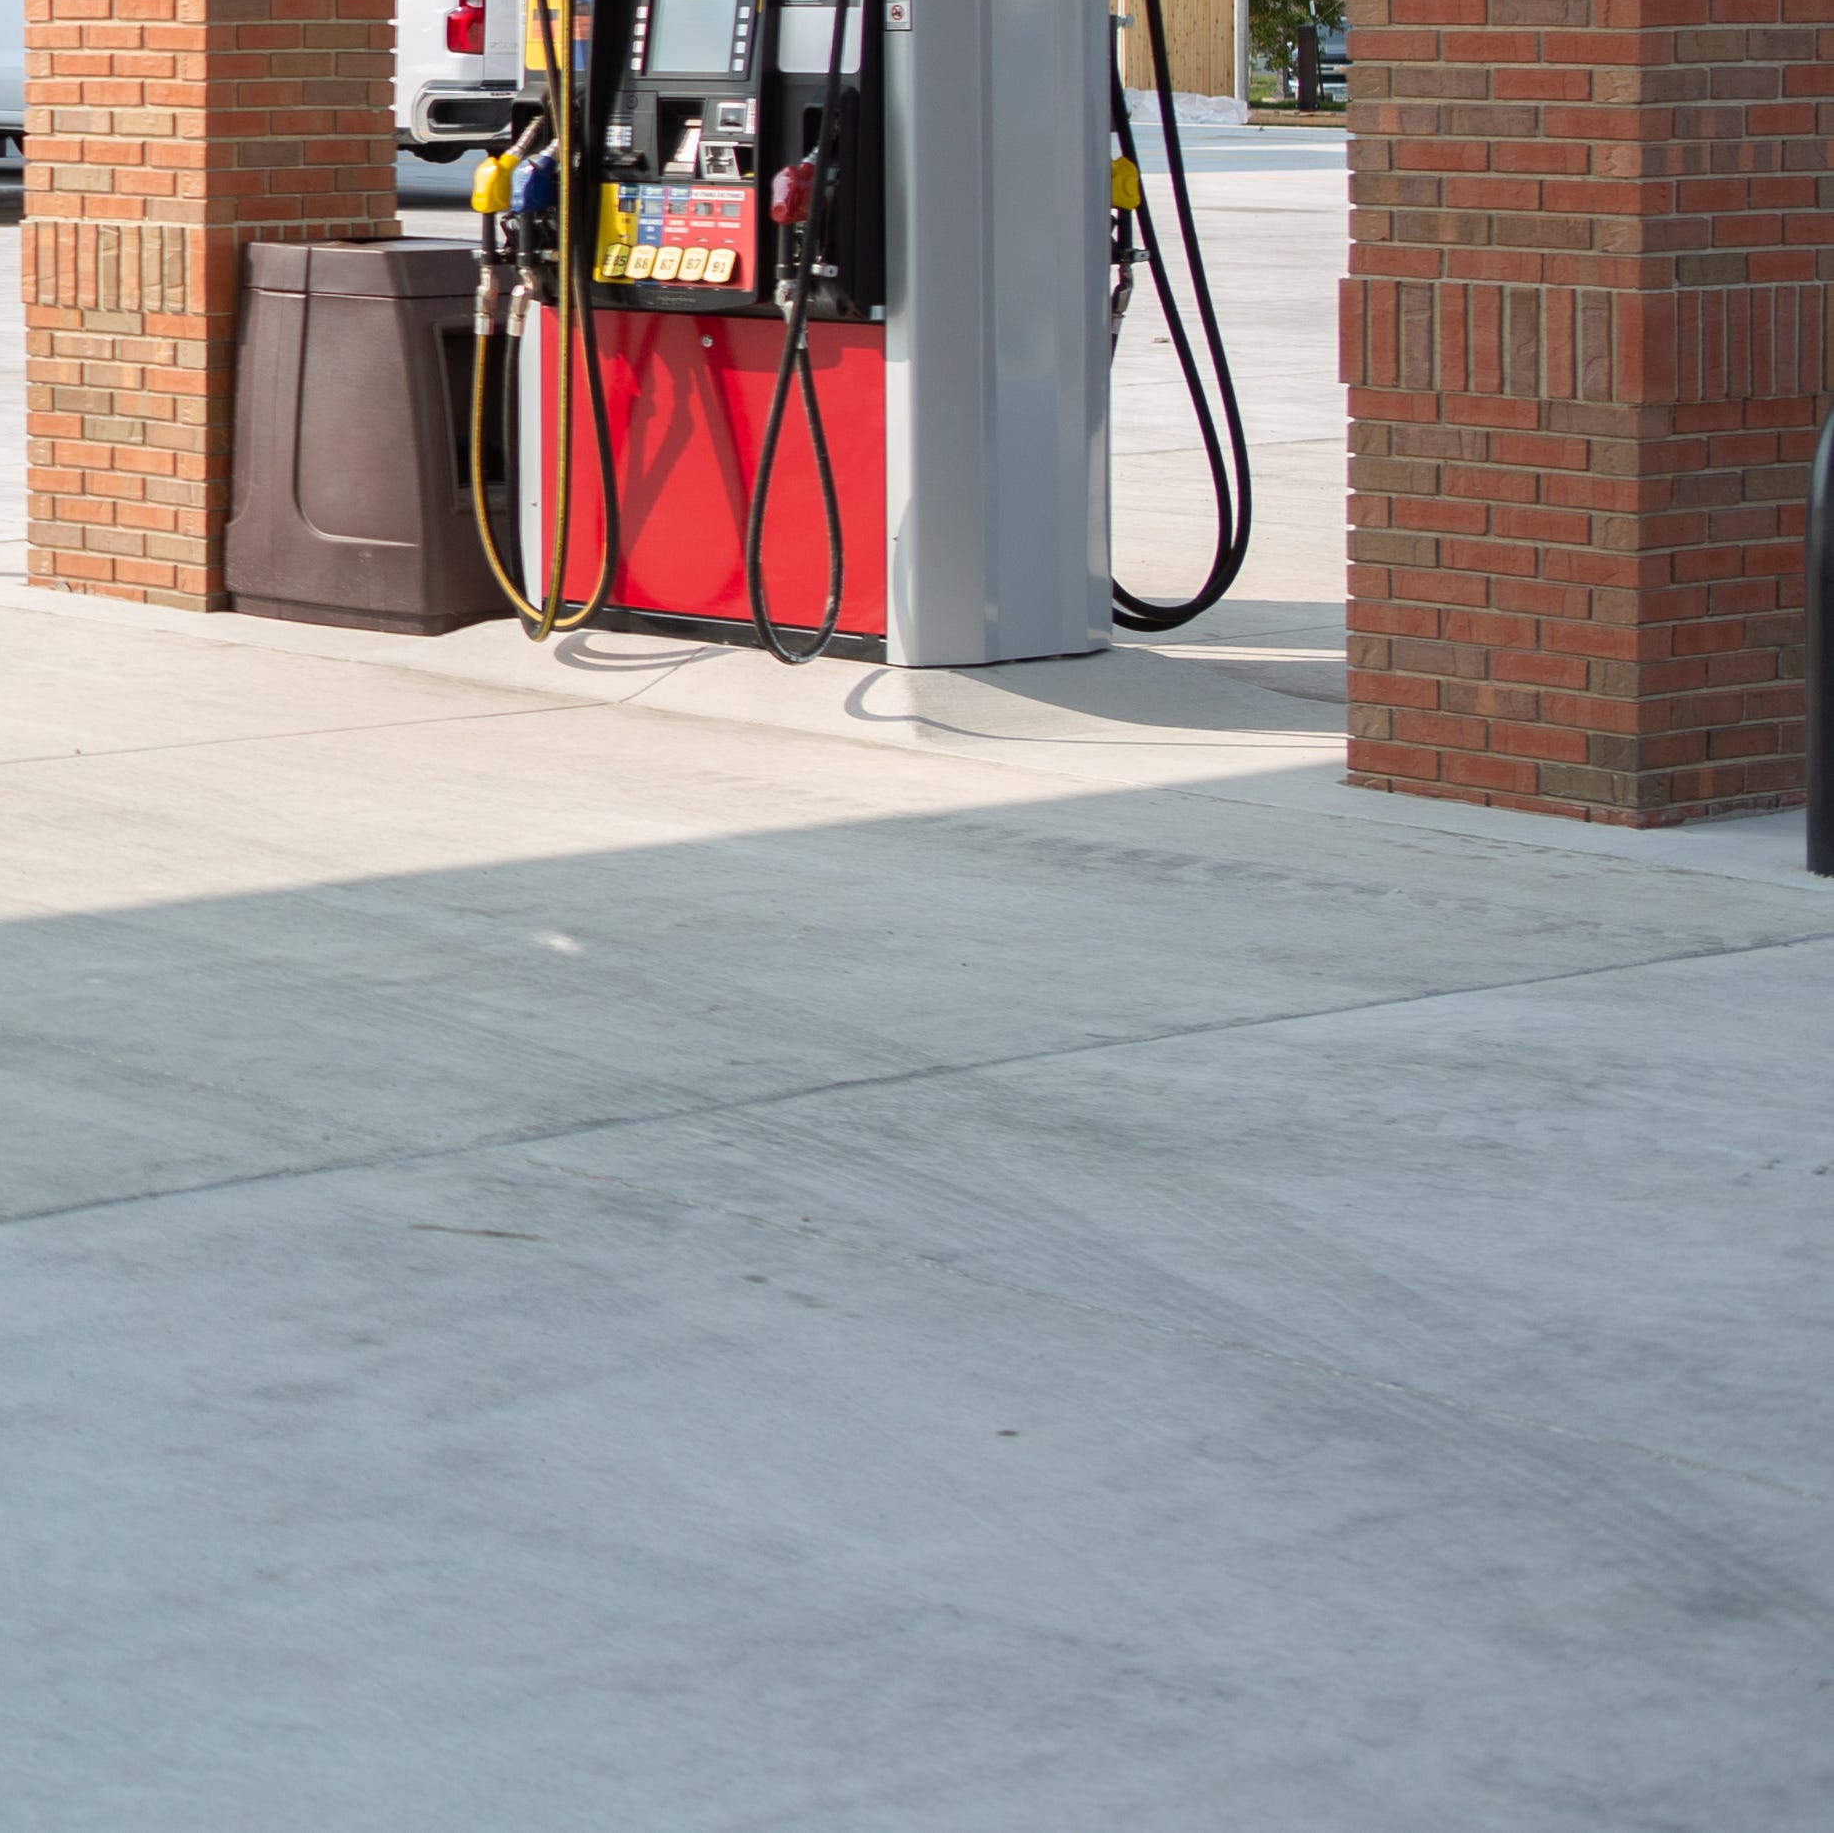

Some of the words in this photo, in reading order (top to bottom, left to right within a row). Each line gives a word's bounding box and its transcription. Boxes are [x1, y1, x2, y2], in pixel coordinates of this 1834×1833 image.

[659, 258, 675, 270] 87
[686, 257, 702, 270] 87
[712, 260, 726, 274] 91
